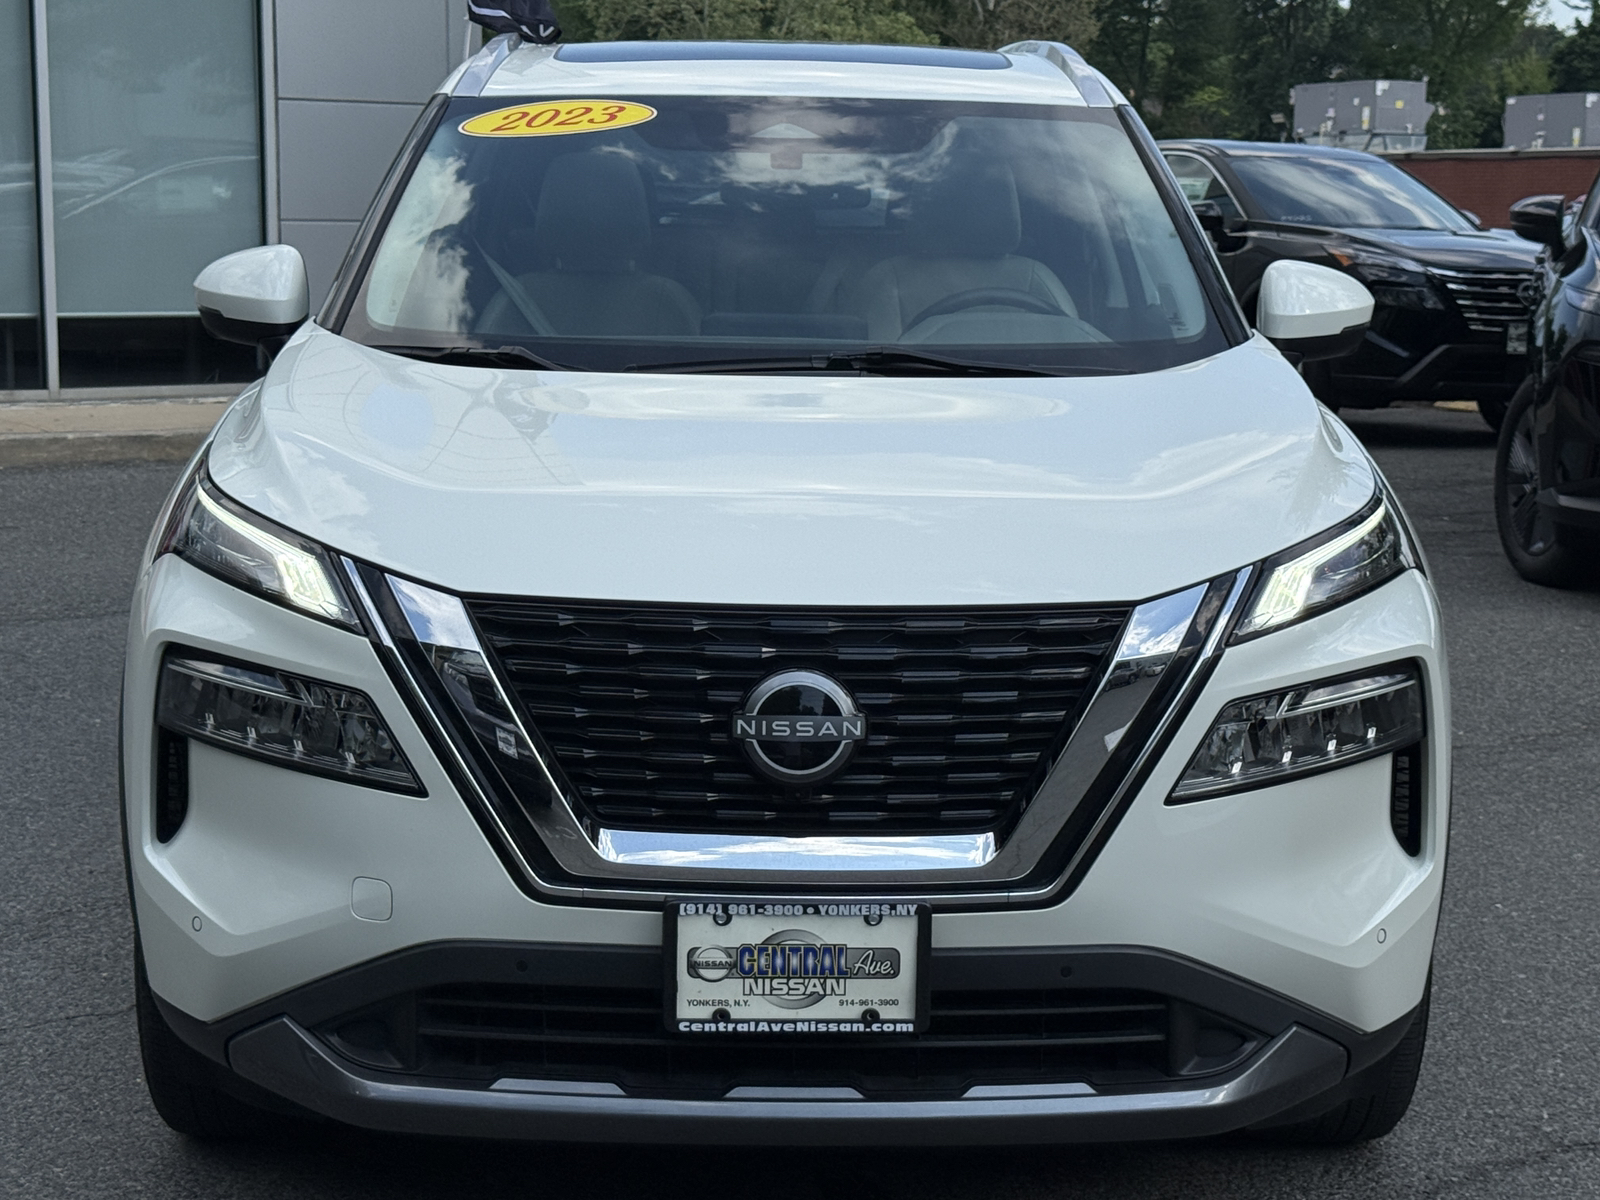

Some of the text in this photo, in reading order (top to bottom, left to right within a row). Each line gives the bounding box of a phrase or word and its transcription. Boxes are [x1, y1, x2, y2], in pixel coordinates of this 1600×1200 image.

[490, 105, 627, 132] 2023
[736, 719, 861, 737] NISSAN
[728, 904, 803, 916] 961-3900
[738, 944, 895, 977] CENTRAL Ave.
[743, 978, 846, 996] NISSAN
[687, 999, 750, 1008] YONKERS, N.Y.
[839, 998, 899, 1007] 914-961-3900
[679, 1021, 914, 1032] CentralAveNissan.com
